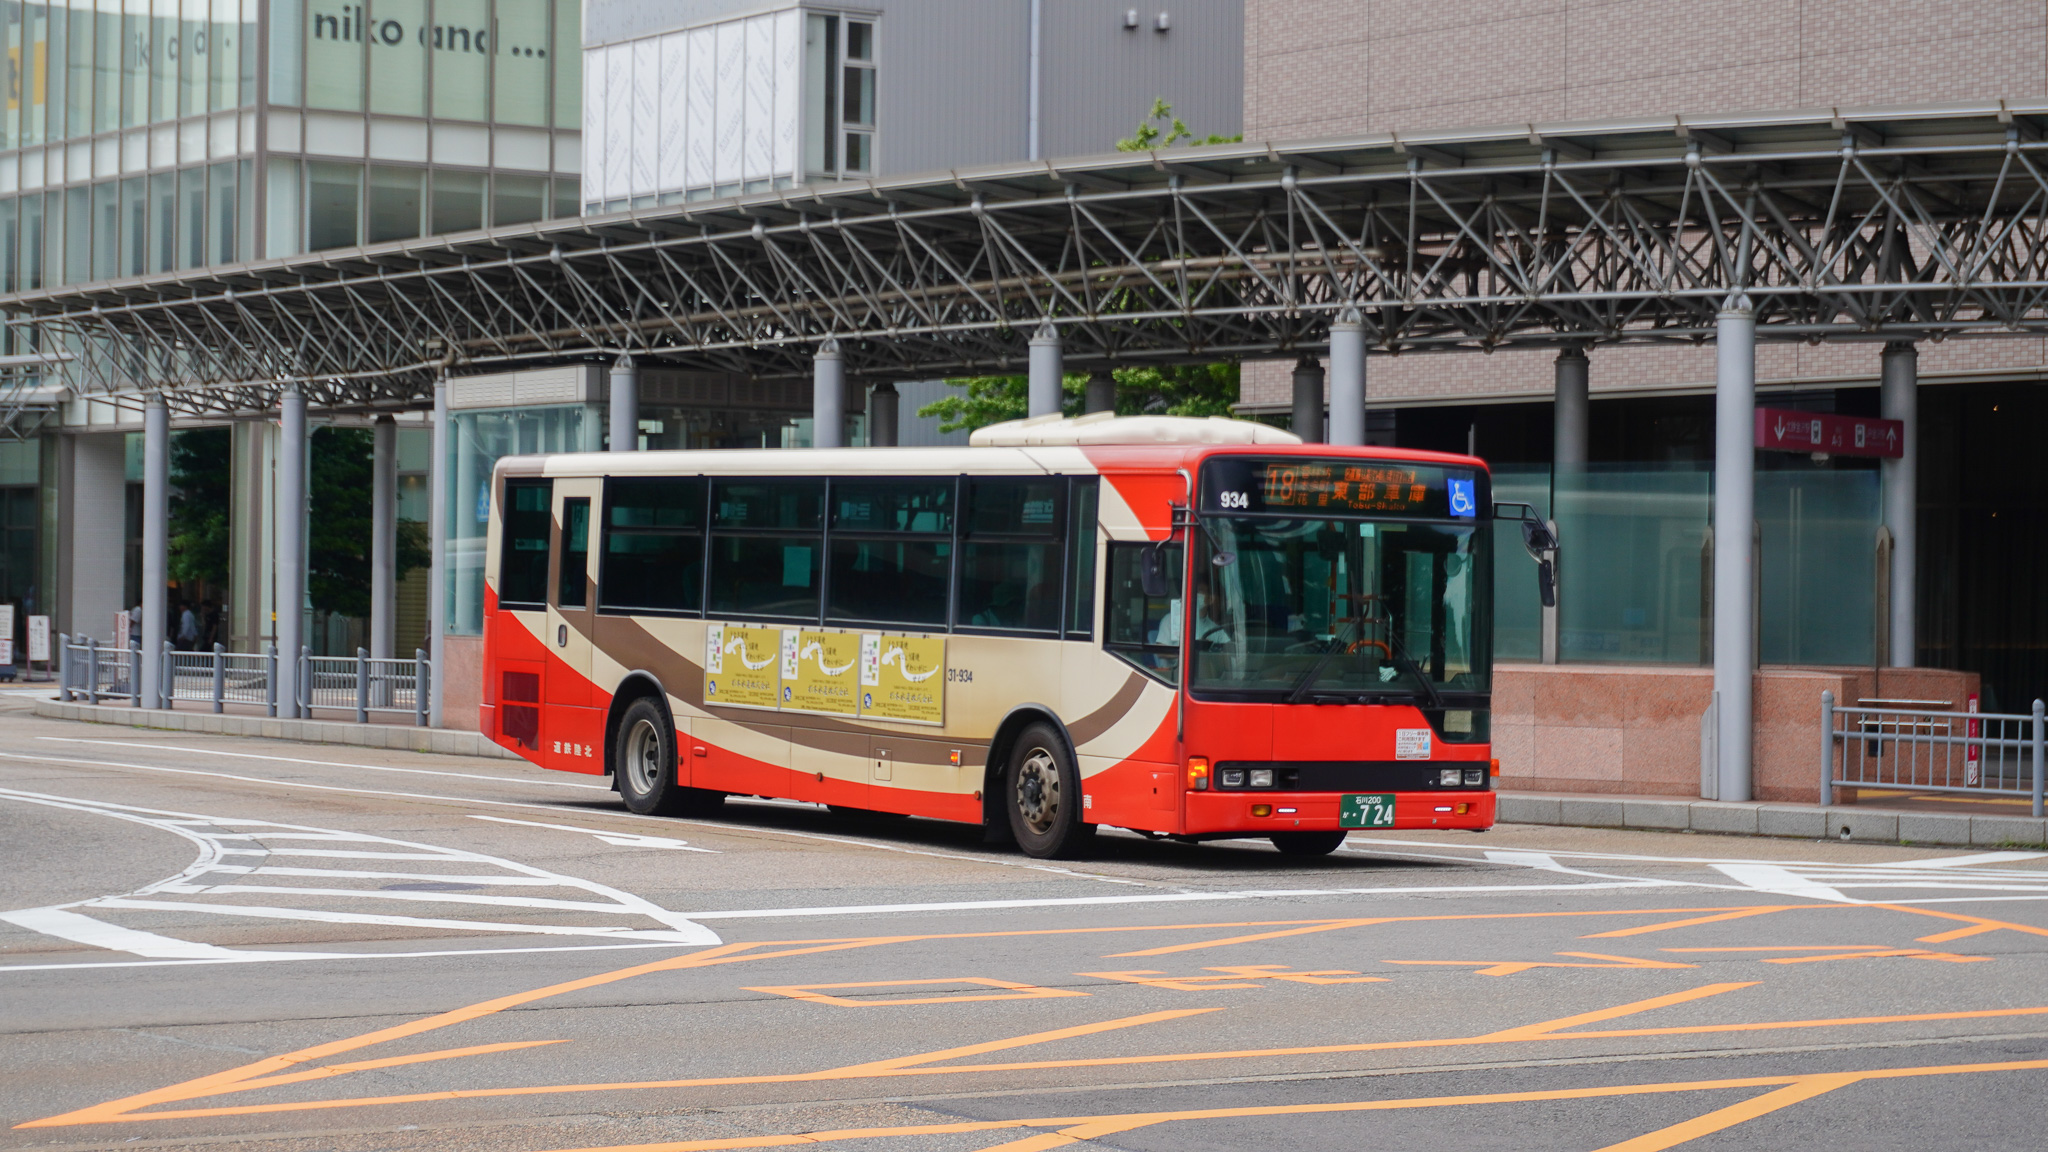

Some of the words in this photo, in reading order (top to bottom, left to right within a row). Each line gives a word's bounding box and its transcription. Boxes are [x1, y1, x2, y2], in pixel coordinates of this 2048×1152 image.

[315, 5, 404, 46] niko
[419, 18, 499, 55] and
[1269, 470, 1294, 500] 18
[1332, 482, 1426, 503] 東部車庫
[1220, 491, 1248, 509] 934
[1083, 794, 1093, 809] 南
